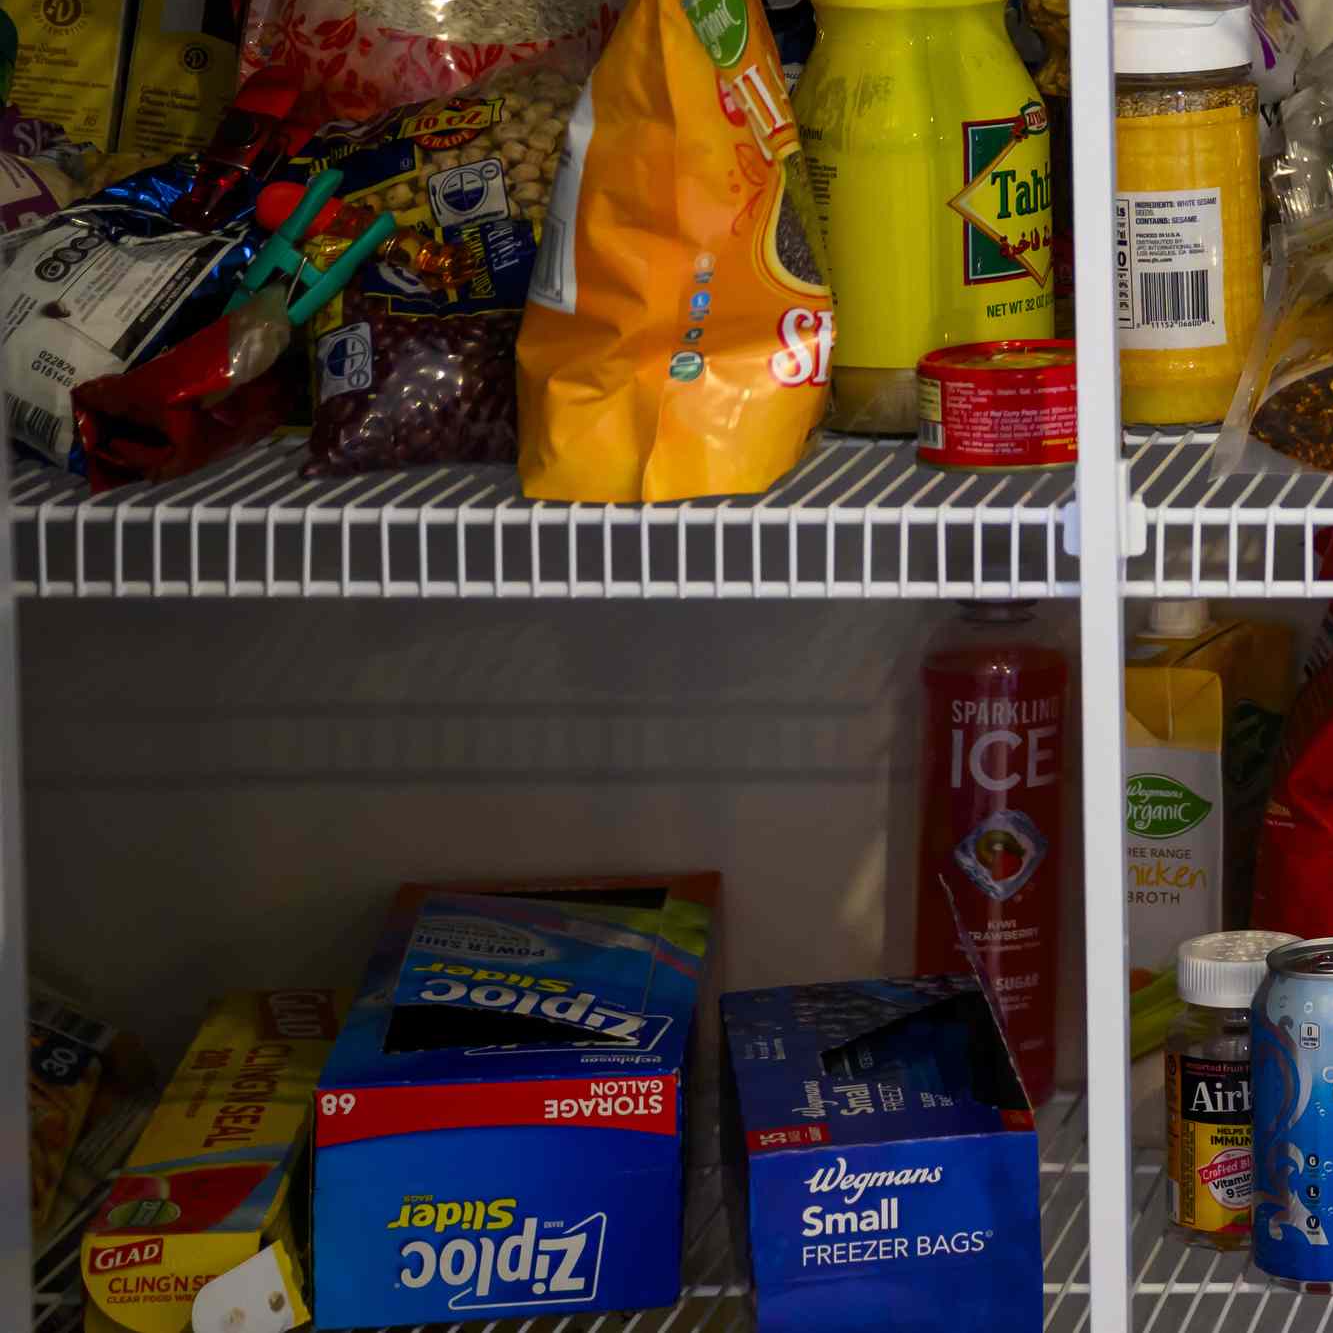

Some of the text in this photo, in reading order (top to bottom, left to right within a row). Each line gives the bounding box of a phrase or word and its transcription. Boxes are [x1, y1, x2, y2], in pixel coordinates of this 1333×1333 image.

[1134, 217, 1170, 226] CONTAINS:
[986, 299, 1023, 317] NET WT
[951, 730, 1057, 792] ICE
[1147, 847, 1192, 860] RANGE
[589, 1078, 665, 1096] GALLON
[543, 1095, 664, 1121] STORAGE
[804, 1157, 943, 1204] Wegmans
[388, 1197, 517, 1231] Slider
[801, 1197, 899, 1237] Small
[95, 1241, 162, 1270] GLAD
[399, 1217, 586, 1299] Ziploc
[801, 1231, 986, 1267] FREEZER BAGS
